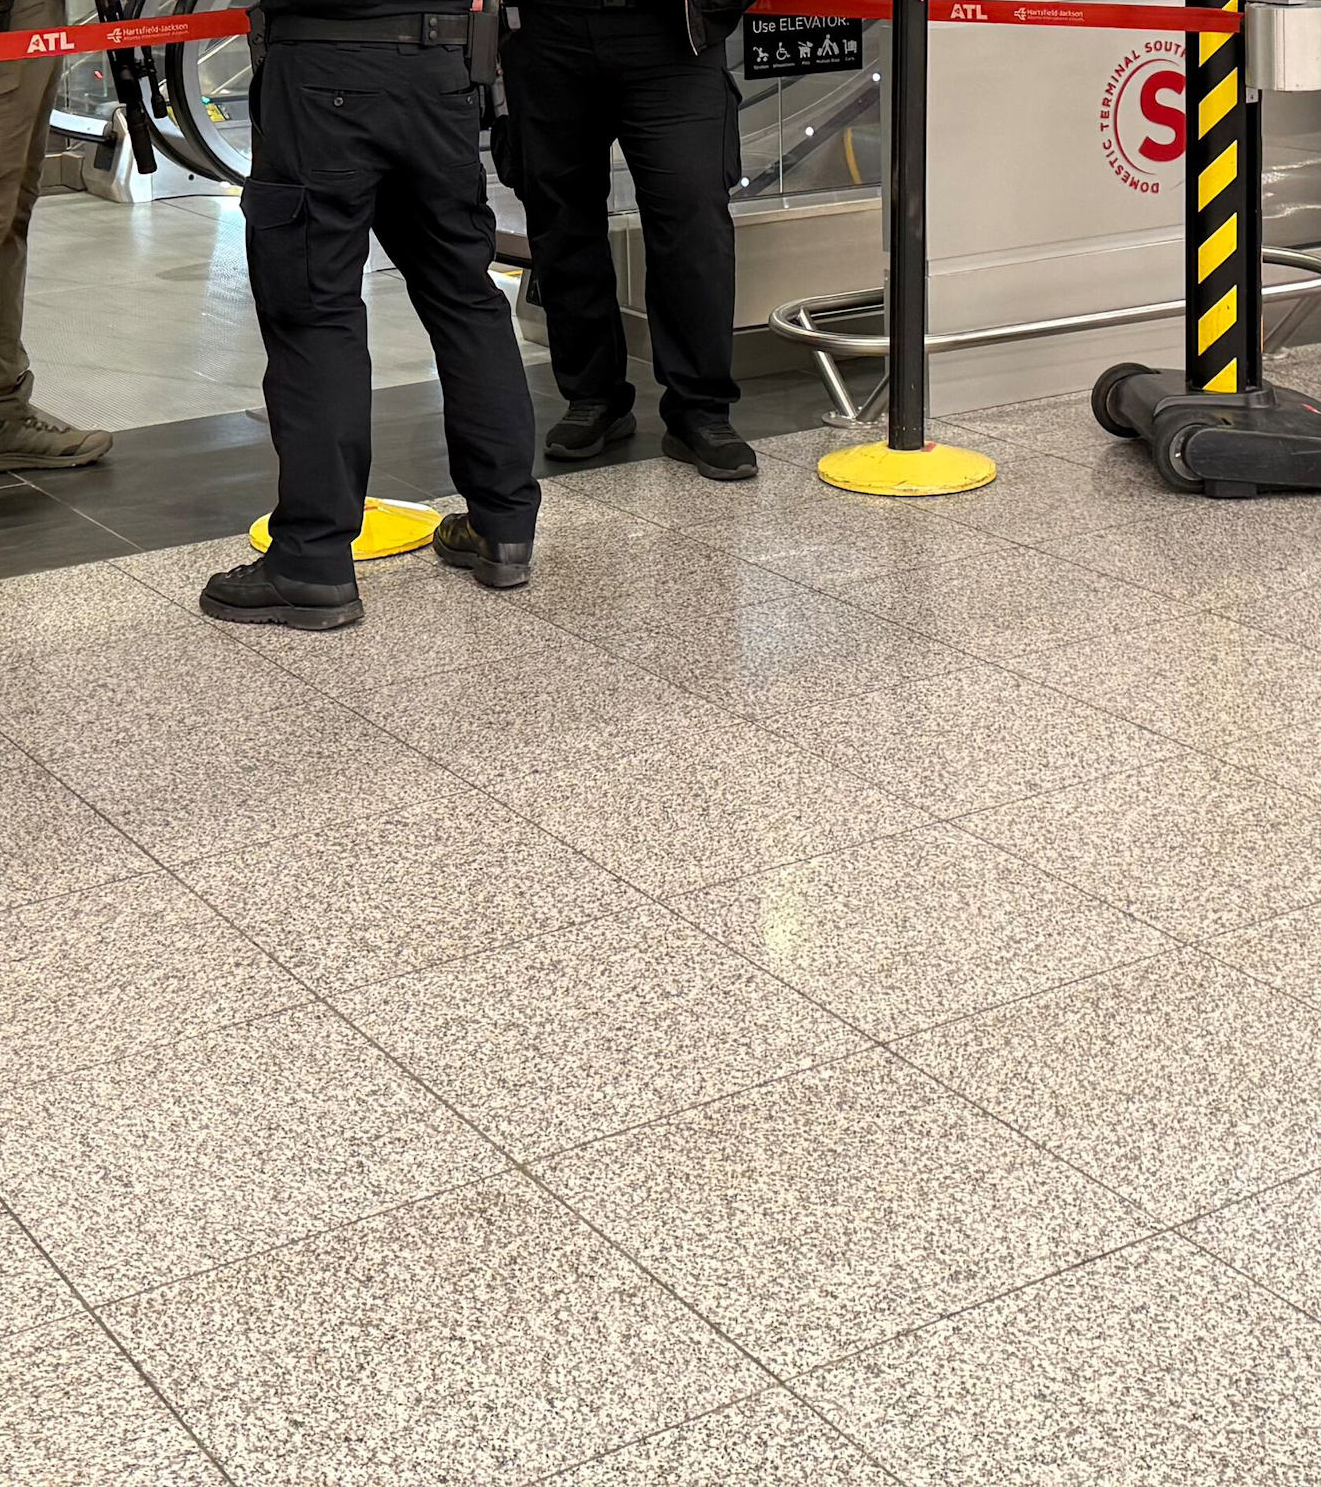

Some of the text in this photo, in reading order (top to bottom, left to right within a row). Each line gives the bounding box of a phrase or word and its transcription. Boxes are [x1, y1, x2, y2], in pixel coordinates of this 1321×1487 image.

[752, 20, 776, 33] Use
[950, 3, 989, 20] ATL
[27, 31, 75, 54] ATL
[1100, 50, 1140, 131] TERMINAL
[1139, 70, 1186, 162] S
[1102, 139, 1159, 194] DOMESTIC
